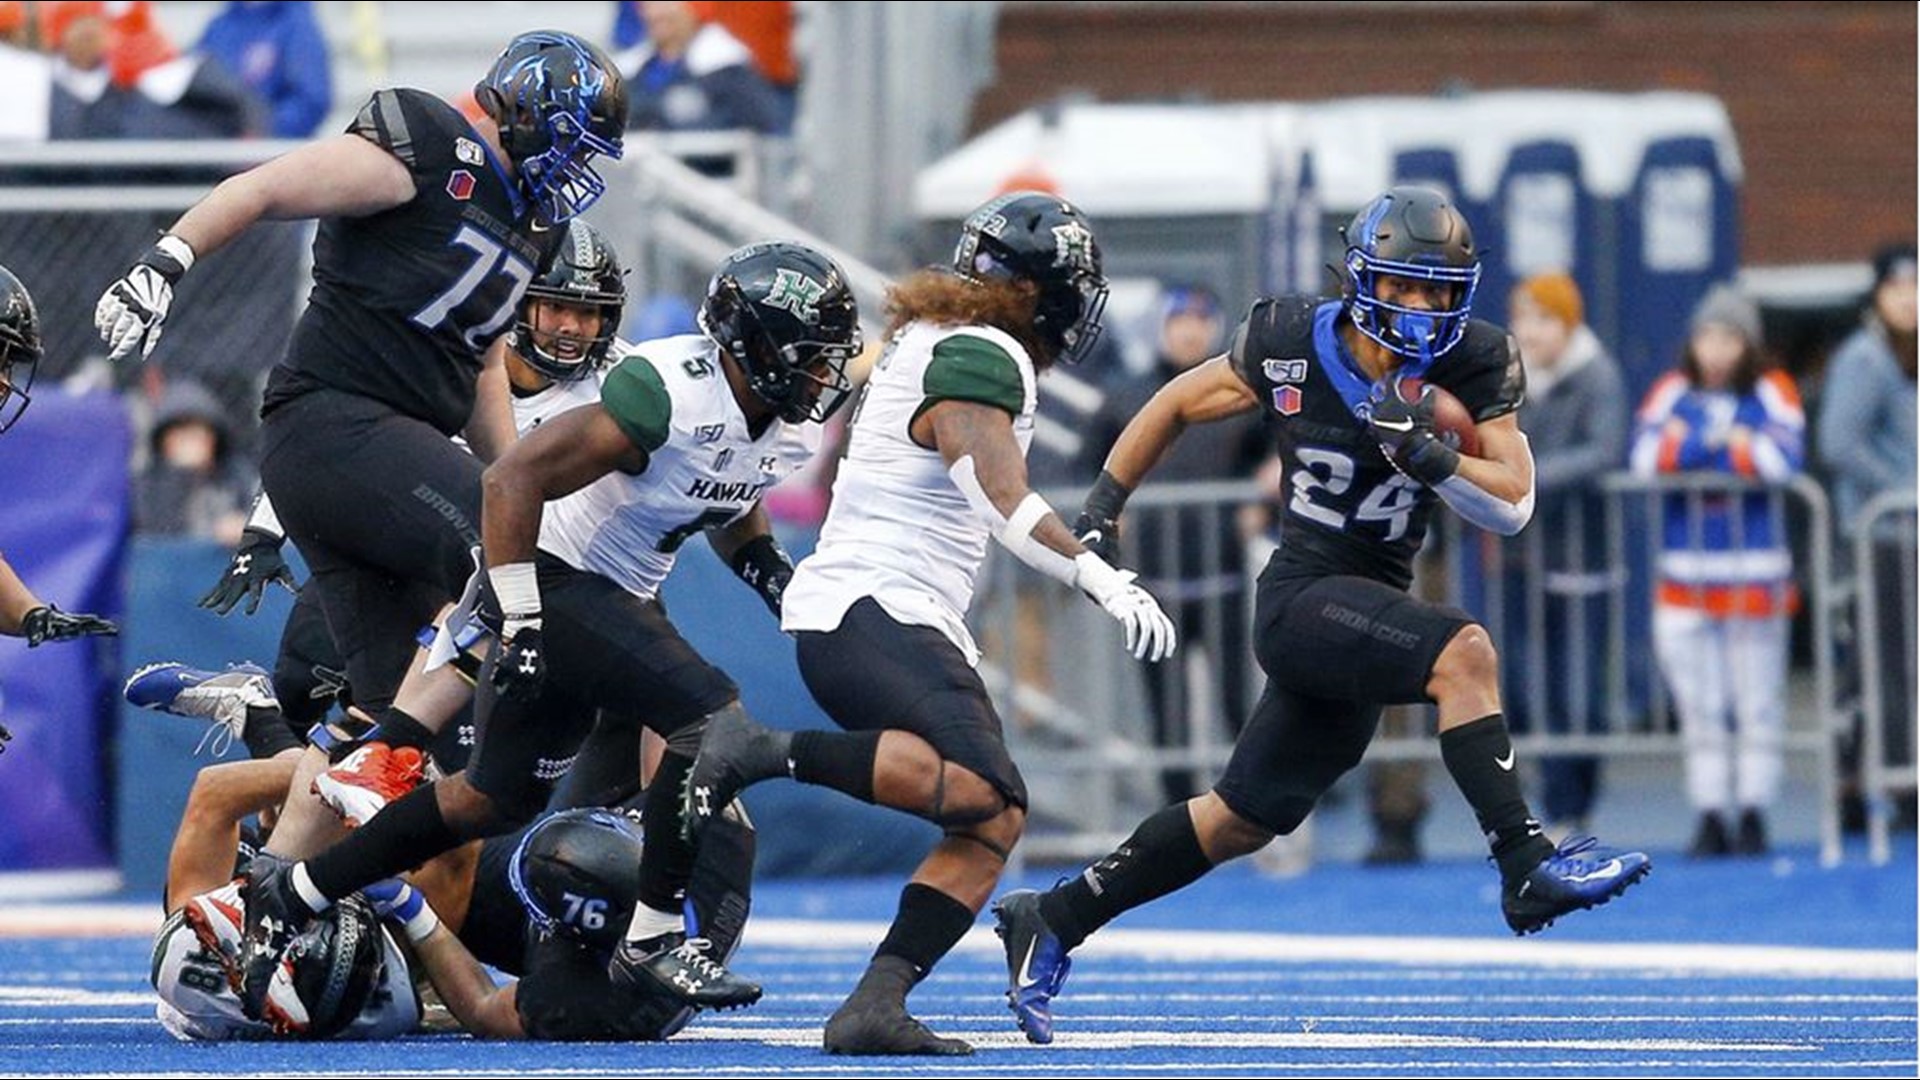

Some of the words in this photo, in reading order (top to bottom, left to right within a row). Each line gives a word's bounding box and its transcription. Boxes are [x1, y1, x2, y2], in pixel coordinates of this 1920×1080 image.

[412, 224, 535, 352] 77
[693, 422, 726, 444] 150
[1289, 447, 1424, 542] 24
[1321, 602, 1421, 651] BRONCOS
[562, 891, 609, 930] 76
